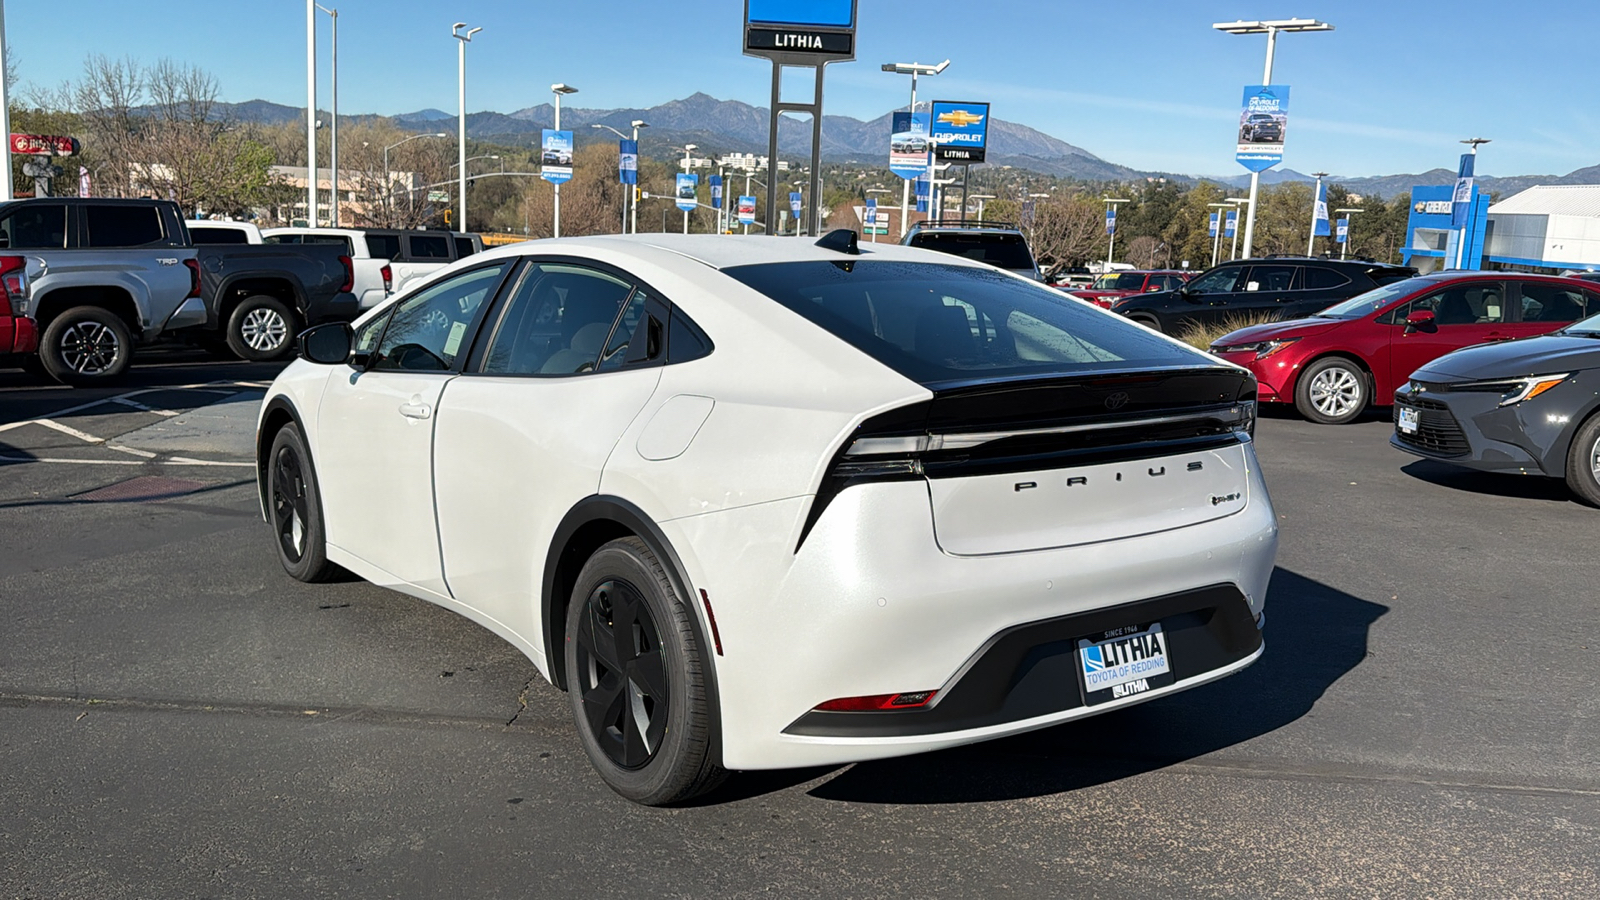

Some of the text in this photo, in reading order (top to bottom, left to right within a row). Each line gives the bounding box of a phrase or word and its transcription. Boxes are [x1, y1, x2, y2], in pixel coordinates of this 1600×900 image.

[775, 34, 823, 49] LITHIA
[1249, 99, 1280, 107] CHEVROLET
[934, 132, 982, 143] CHEVROLET
[944, 150, 970, 159] LITHIA
[1014, 461, 1203, 492] PRIUS
[1104, 625, 1138, 638] SINCE 1946
[1101, 633, 1163, 668] LITHIA
[1087, 657, 1165, 684] TOYOTA OF REDDING
[1121, 679, 1150, 696] LITHIA
